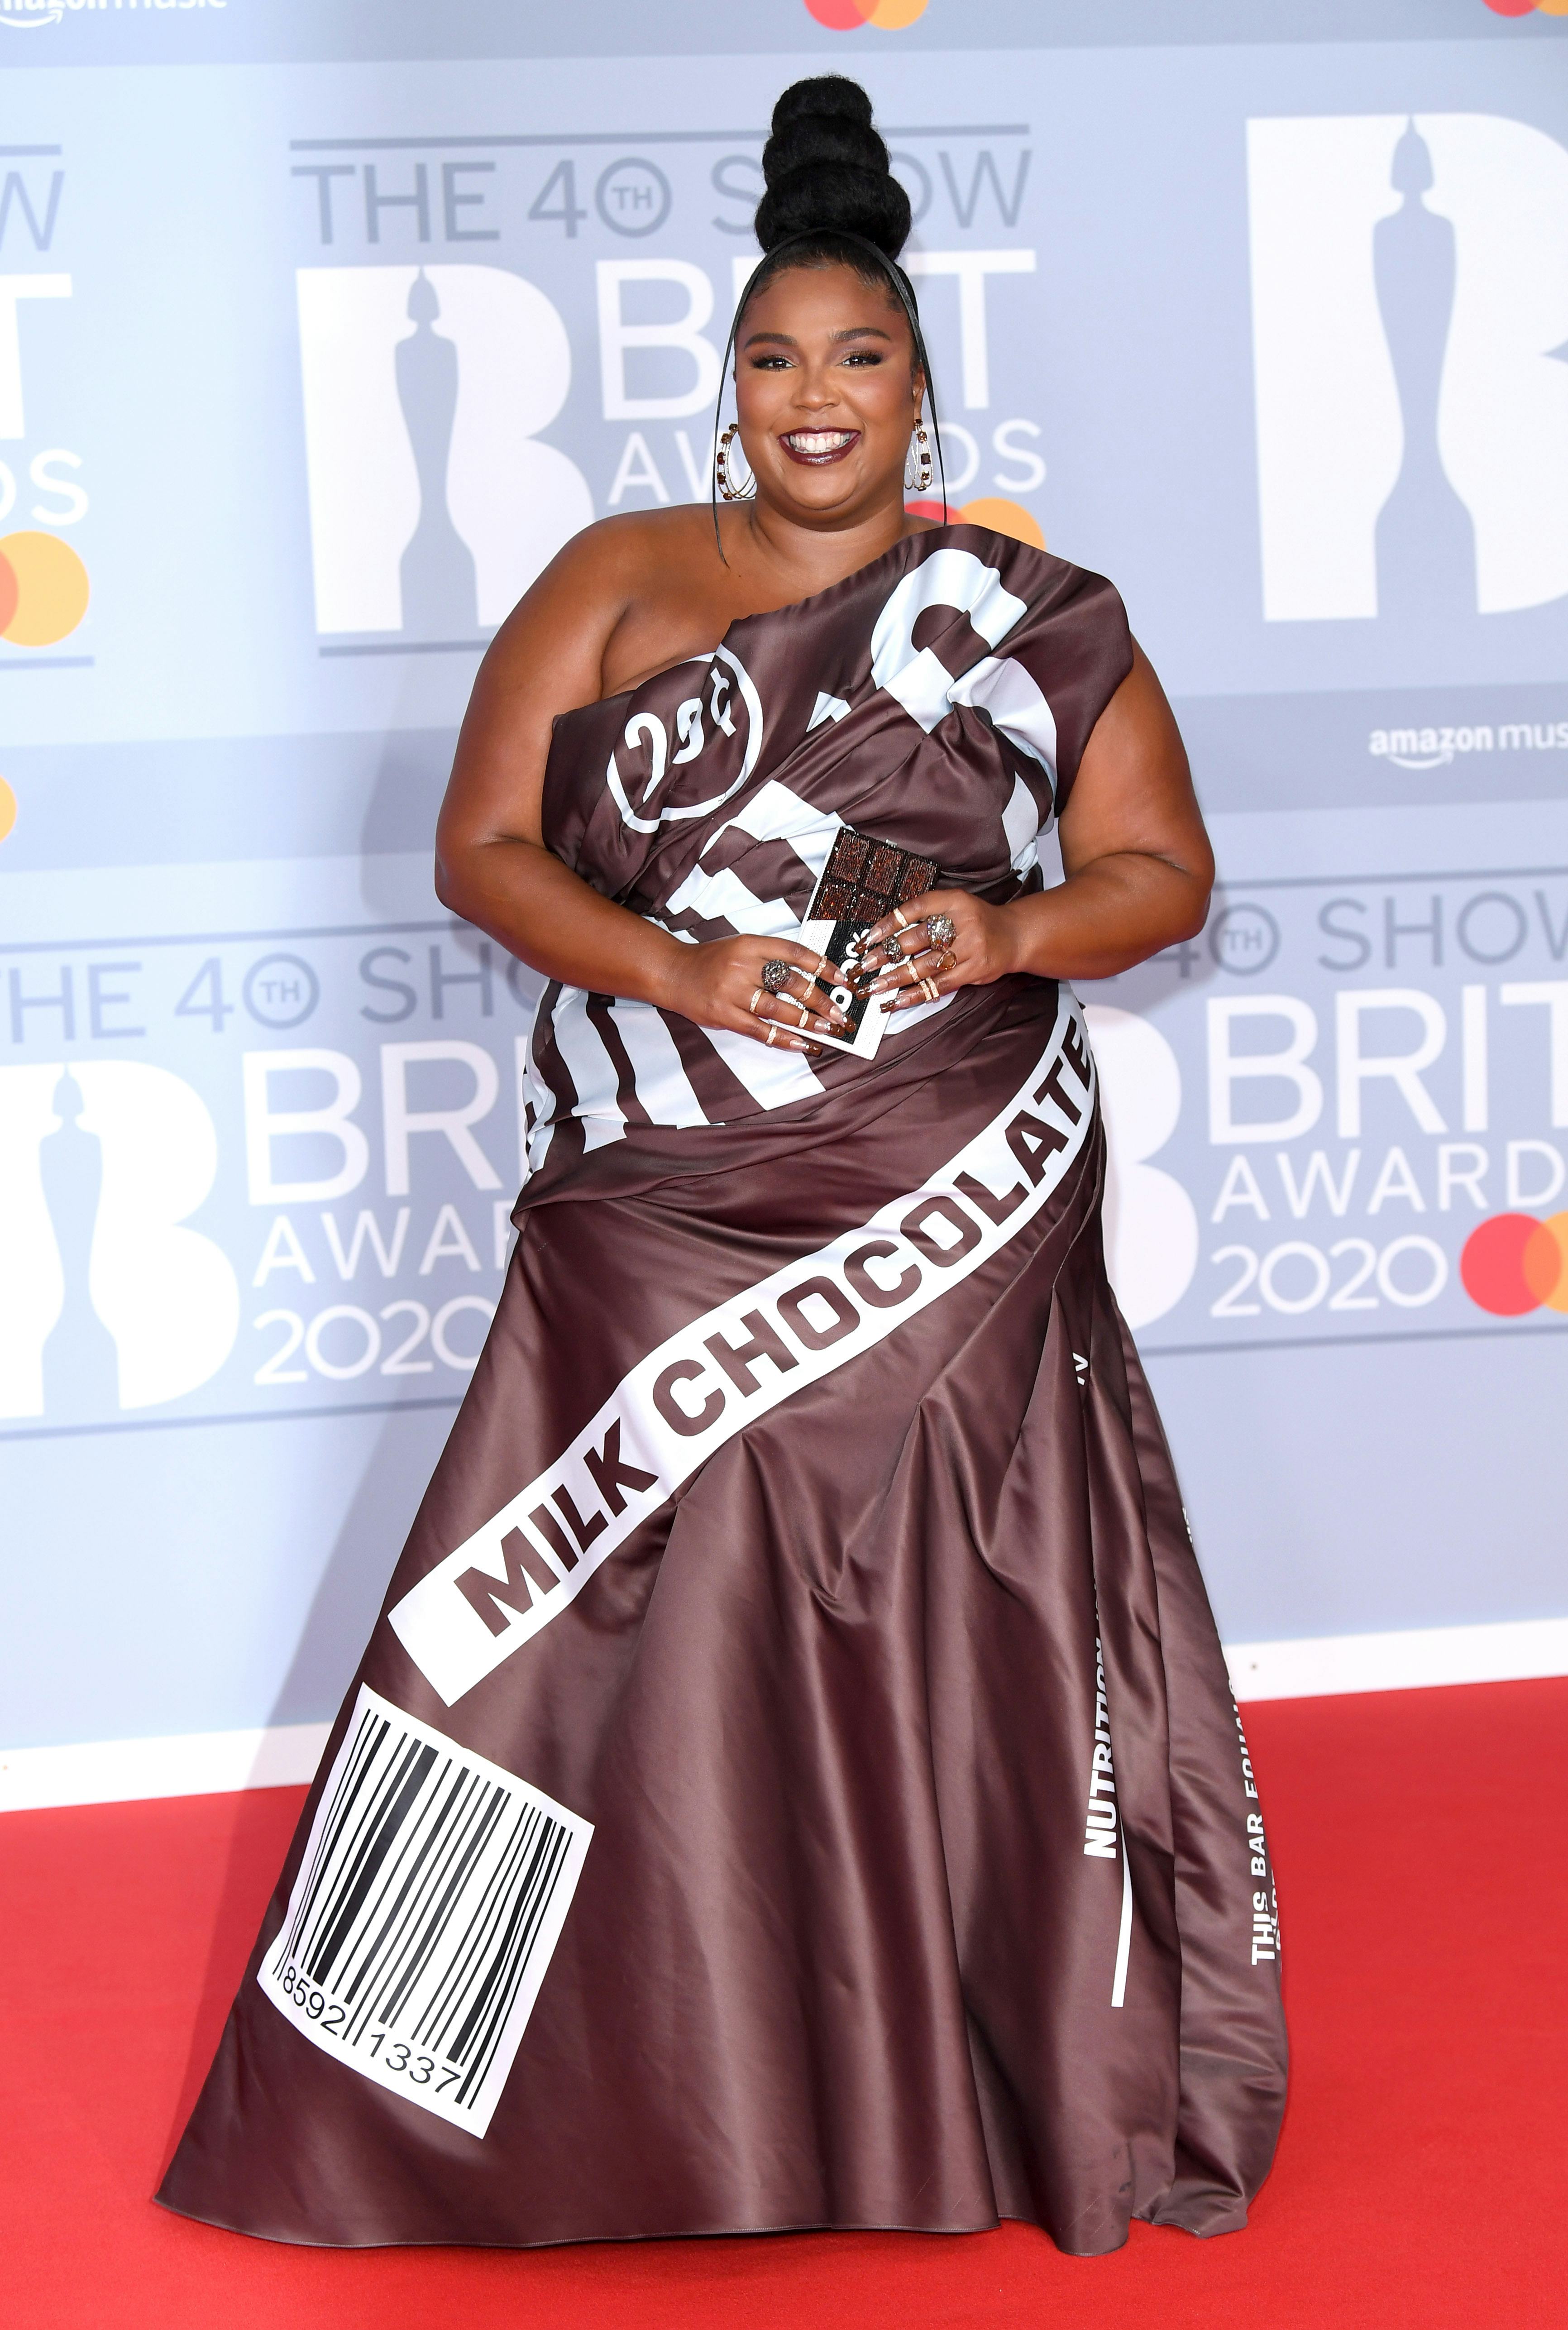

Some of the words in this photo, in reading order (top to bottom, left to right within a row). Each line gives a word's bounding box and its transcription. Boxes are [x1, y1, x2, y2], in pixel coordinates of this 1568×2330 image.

[291, 162, 500, 244] THE
[711, 149, 1032, 234] SW
[596, 249, 1036, 421] BT
[609, 418, 1047, 505] AWDS
[1369, 726, 1494, 757] amazon
[1206, 980, 1568, 1144] BRIT
[1211, 1140, 1567, 1224] AWARD
[1210, 1235, 1449, 1318] 2020
[253, 1296, 494, 1385] 2020
[454, 1416, 659, 1638] MILK
[652, 1014, 1091, 1436] CHOCOLATE
[1083, 1637, 1117, 1859] NUTRIT
[1247, 1813, 1267, 1877] BAR
[1251, 1891, 1276, 1966] THIS
[283, 1966, 346, 2036] 8592
[369, 2033, 461, 2093] 1337
